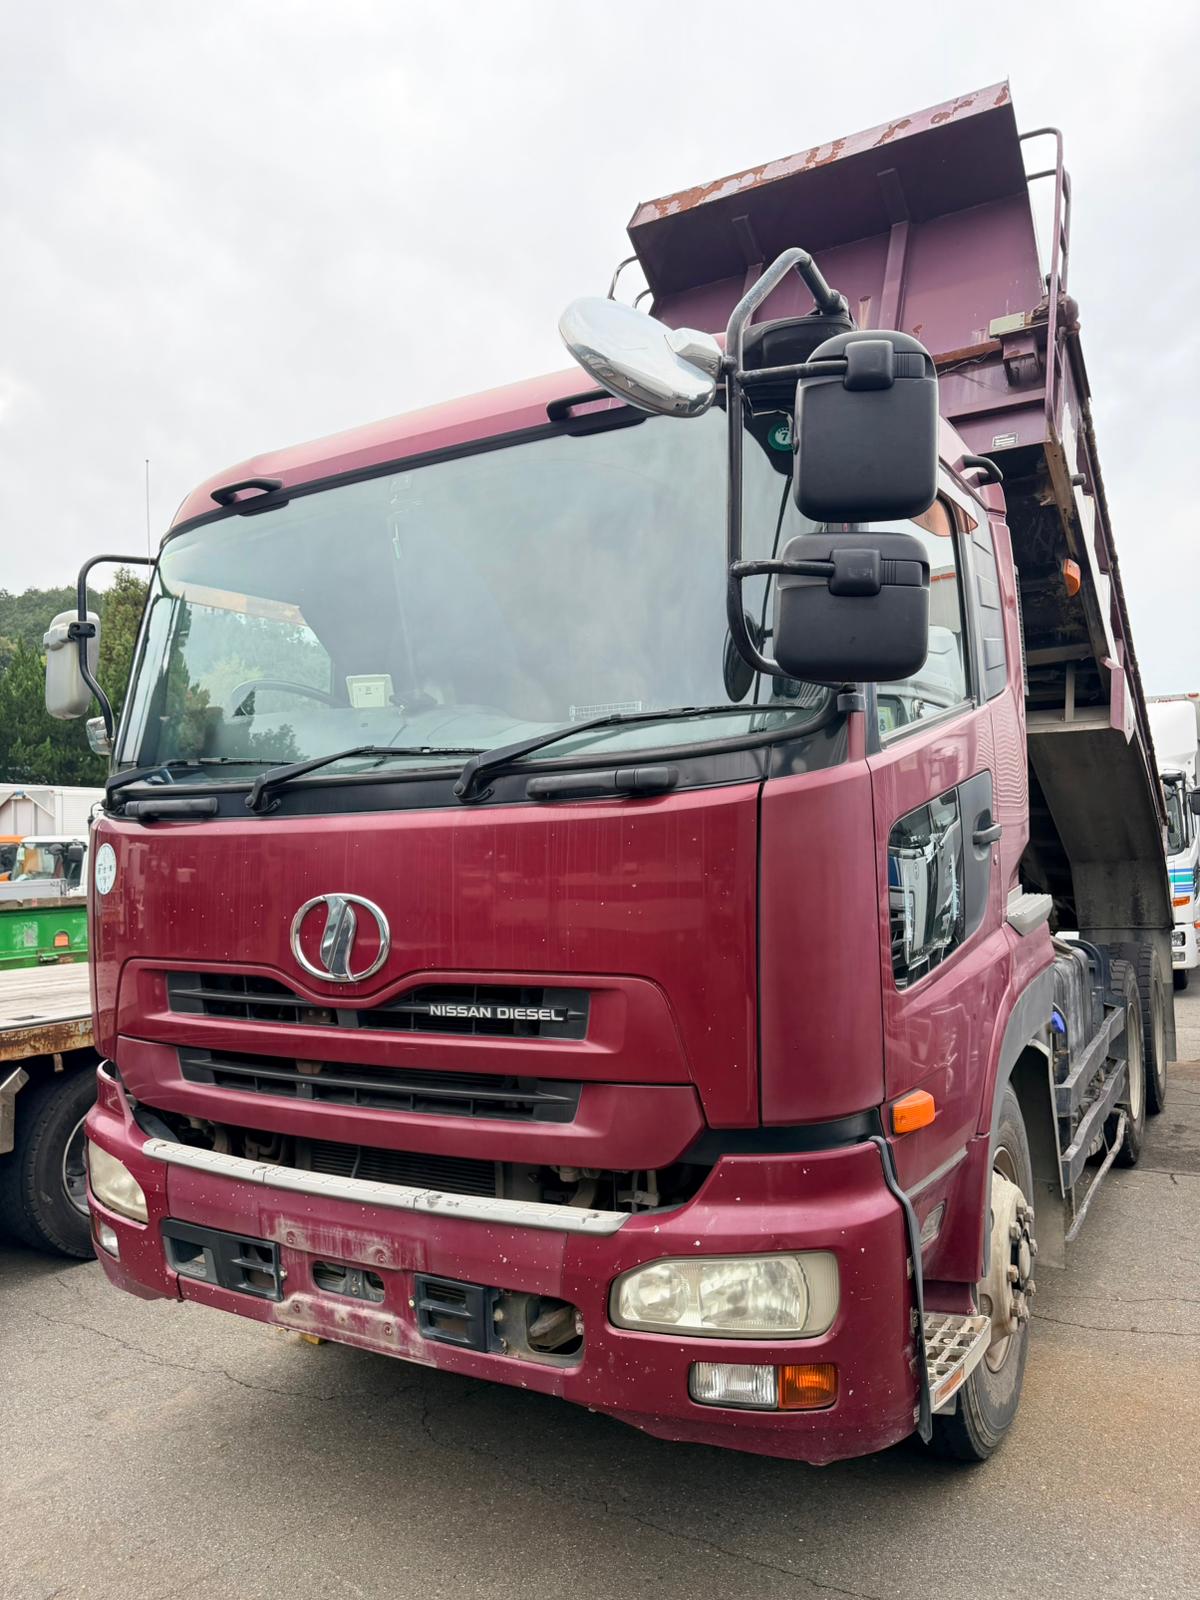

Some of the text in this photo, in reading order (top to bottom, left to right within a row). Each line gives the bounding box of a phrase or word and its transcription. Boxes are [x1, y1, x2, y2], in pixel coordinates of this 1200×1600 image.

[781, 432, 788, 441] 7
[430, 1005, 564, 1021] NISSAN DIESEL
